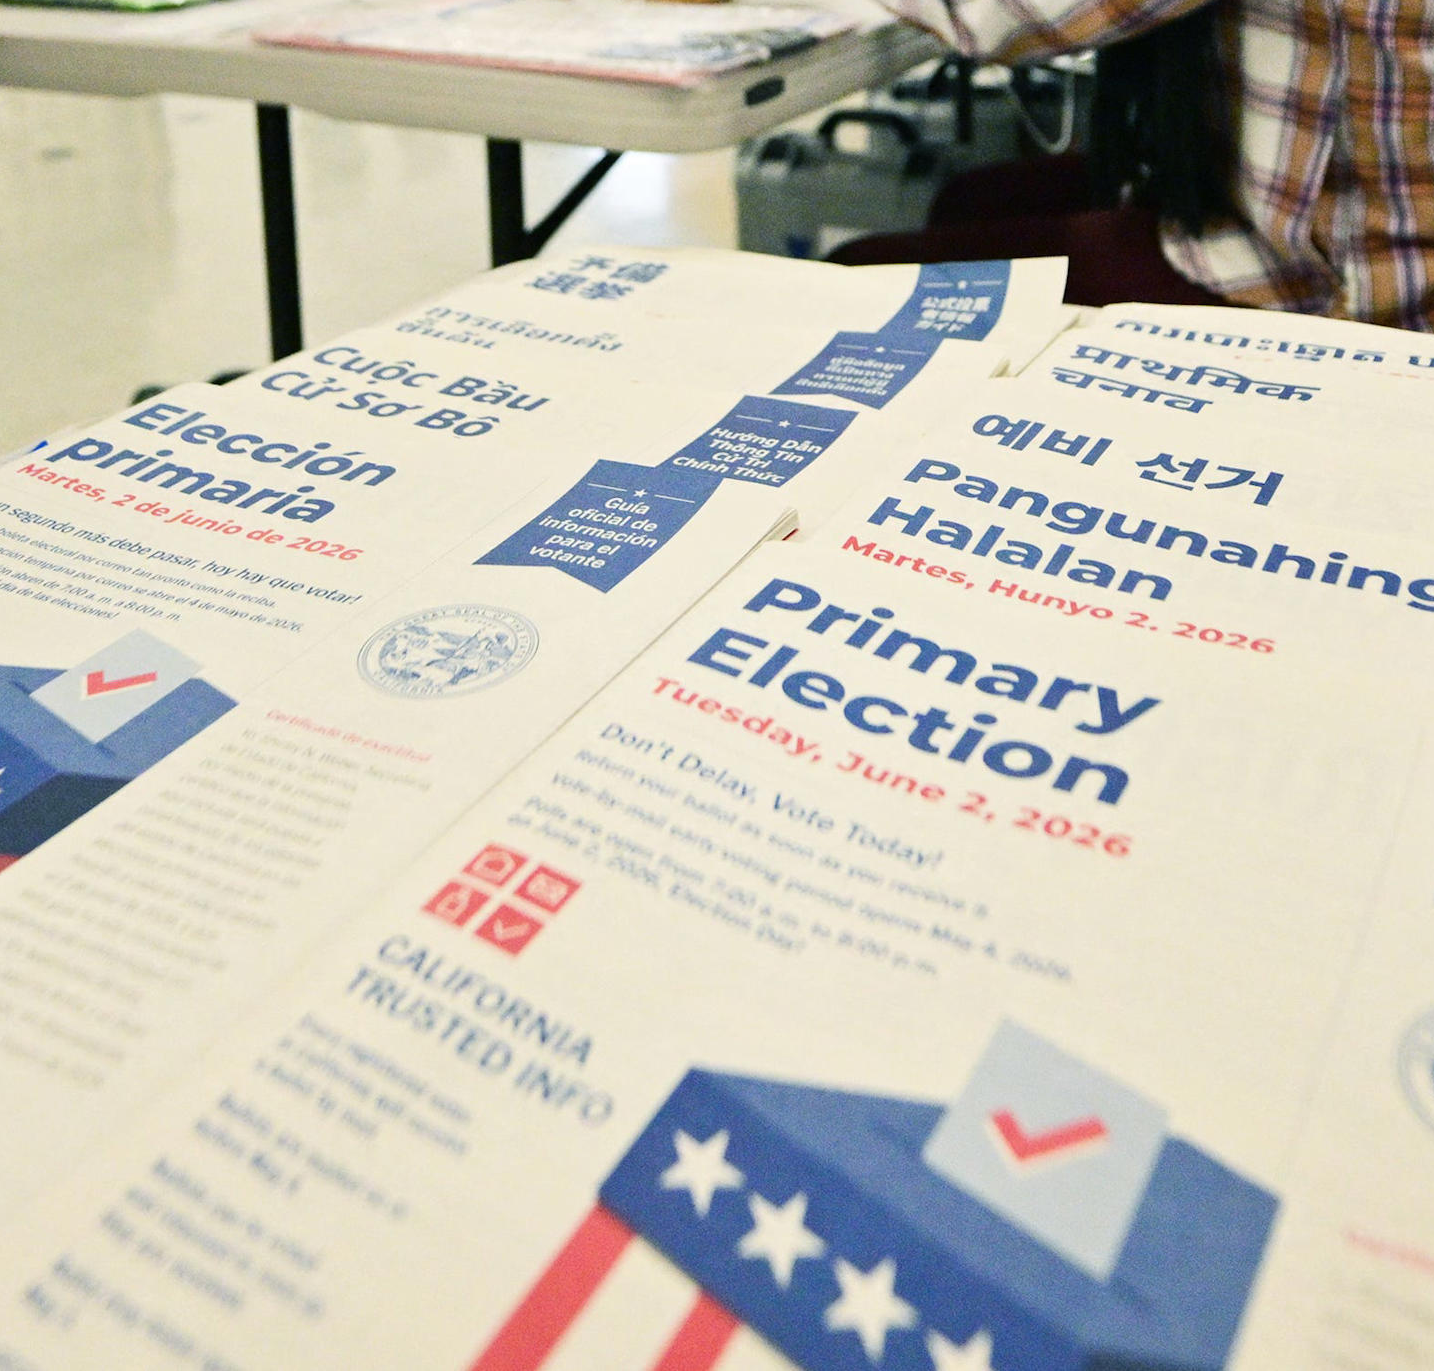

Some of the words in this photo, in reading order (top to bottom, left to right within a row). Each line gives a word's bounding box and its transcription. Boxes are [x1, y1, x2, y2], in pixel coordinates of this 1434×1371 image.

[261, 371, 347, 400] Cử
[313, 346, 439, 389] Cuộc
[439, 379, 550, 412] Bầu
[123, 402, 396, 486] Elección
[672, 457, 730, 473] Chính
[733, 467, 785, 483] Thức
[709, 428, 779, 447] Hướng
[709, 439, 769, 458] Thông
[773, 450, 804, 464] Tin
[711, 452, 745, 462] Cử
[745, 458, 772, 468] Tri
[971, 413, 1113, 468] 예비
[1135, 452, 1284, 507] 선거
[17, 463, 106, 501] Martes,
[112, 494, 136, 507] 2
[135, 500, 171, 518] de
[165, 508, 243, 536] junio
[246, 528, 284, 544] de
[287, 536, 364, 562] 2026
[45, 437, 335, 523] primaria
[605, 498, 650, 515] Guía
[8, 509, 74, 534] segundo
[75, 530, 110, 544] más
[109, 537, 152, 555] debe
[147, 550, 197, 570] pasar,
[201, 561, 237, 576] hoy
[235, 568, 269, 583] hay
[268, 577, 305, 592] que
[306, 586, 363, 605] votar!
[529, 546, 606, 569] votante
[539, 516, 658, 548] información
[545, 535, 594, 551] para
[597, 545, 621, 555] el
[568, 508, 631, 527] oficial
[631, 519, 658, 532] de
[867, 496, 1174, 602] Halalan
[21, 555, 75, 576] temprana
[74, 569, 93, 581] por
[91, 573, 133, 593] correo
[133, 588, 146, 597] se
[145, 588, 176, 604] abre
[175, 595, 190, 604] el
[189, 599, 197, 607] 4
[197, 602, 215, 612] de
[215, 604, 248, 621] mayo
[247, 611, 267, 623] de
[30, 538, 76, 558] electoral
[75, 553, 94, 564] por
[95, 556, 132, 573] correo
[132, 568, 152, 578] tan
[149, 572, 191, 586] pronto
[190, 581, 224, 595] como
[224, 588, 238, 599] la
[238, 592, 276, 608] reciba.
[841, 535, 975, 590] Martes,
[987, 579, 1113, 620] Hunyo
[1173, 621, 1276, 654] 2026
[742, 577, 1163, 735] Primary
[686, 626, 1130, 806] Election
[600, 721, 675, 762] Don't
[678, 752, 758, 805] Delay,
[773, 792, 835, 831] Vote
[847, 821, 945, 868] Today!
[651, 676, 823, 764] Tuesday,
[836, 750, 948, 803] June
[957, 791, 997, 824] 2,
[1012, 805, 1133, 859] 2026
[378, 935, 593, 1066] CALIFORNIA
[346, 964, 515, 1075] TRUSTED
[515, 1060, 616, 1126] INFO
